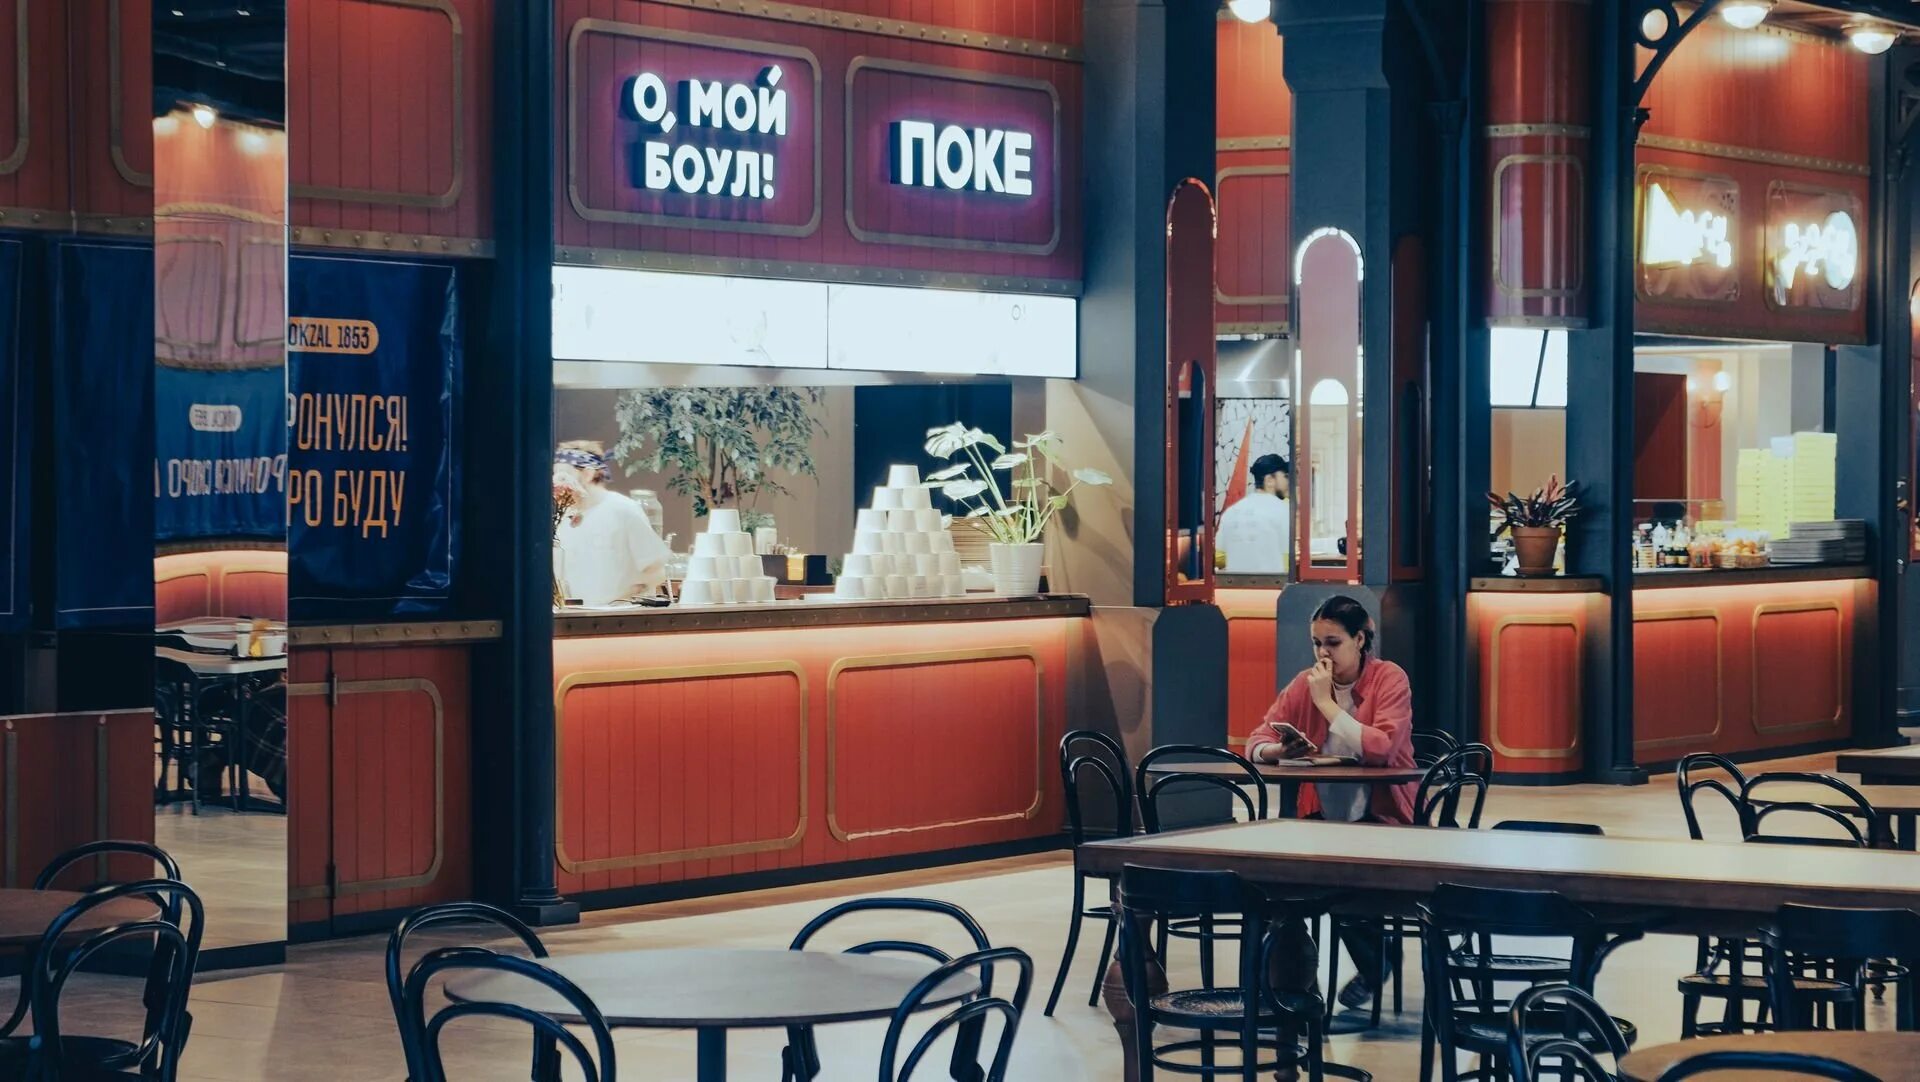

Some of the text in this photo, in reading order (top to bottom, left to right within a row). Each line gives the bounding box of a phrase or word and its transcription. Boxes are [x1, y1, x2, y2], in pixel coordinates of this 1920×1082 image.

[633, 64, 787, 136] О, МОЙ
[644, 140, 775, 200] БОУЛ!
[900, 119, 1033, 196] ПОКЕ
[337, 325, 370, 349] 1853
[333, 469, 406, 539] БУДУ
